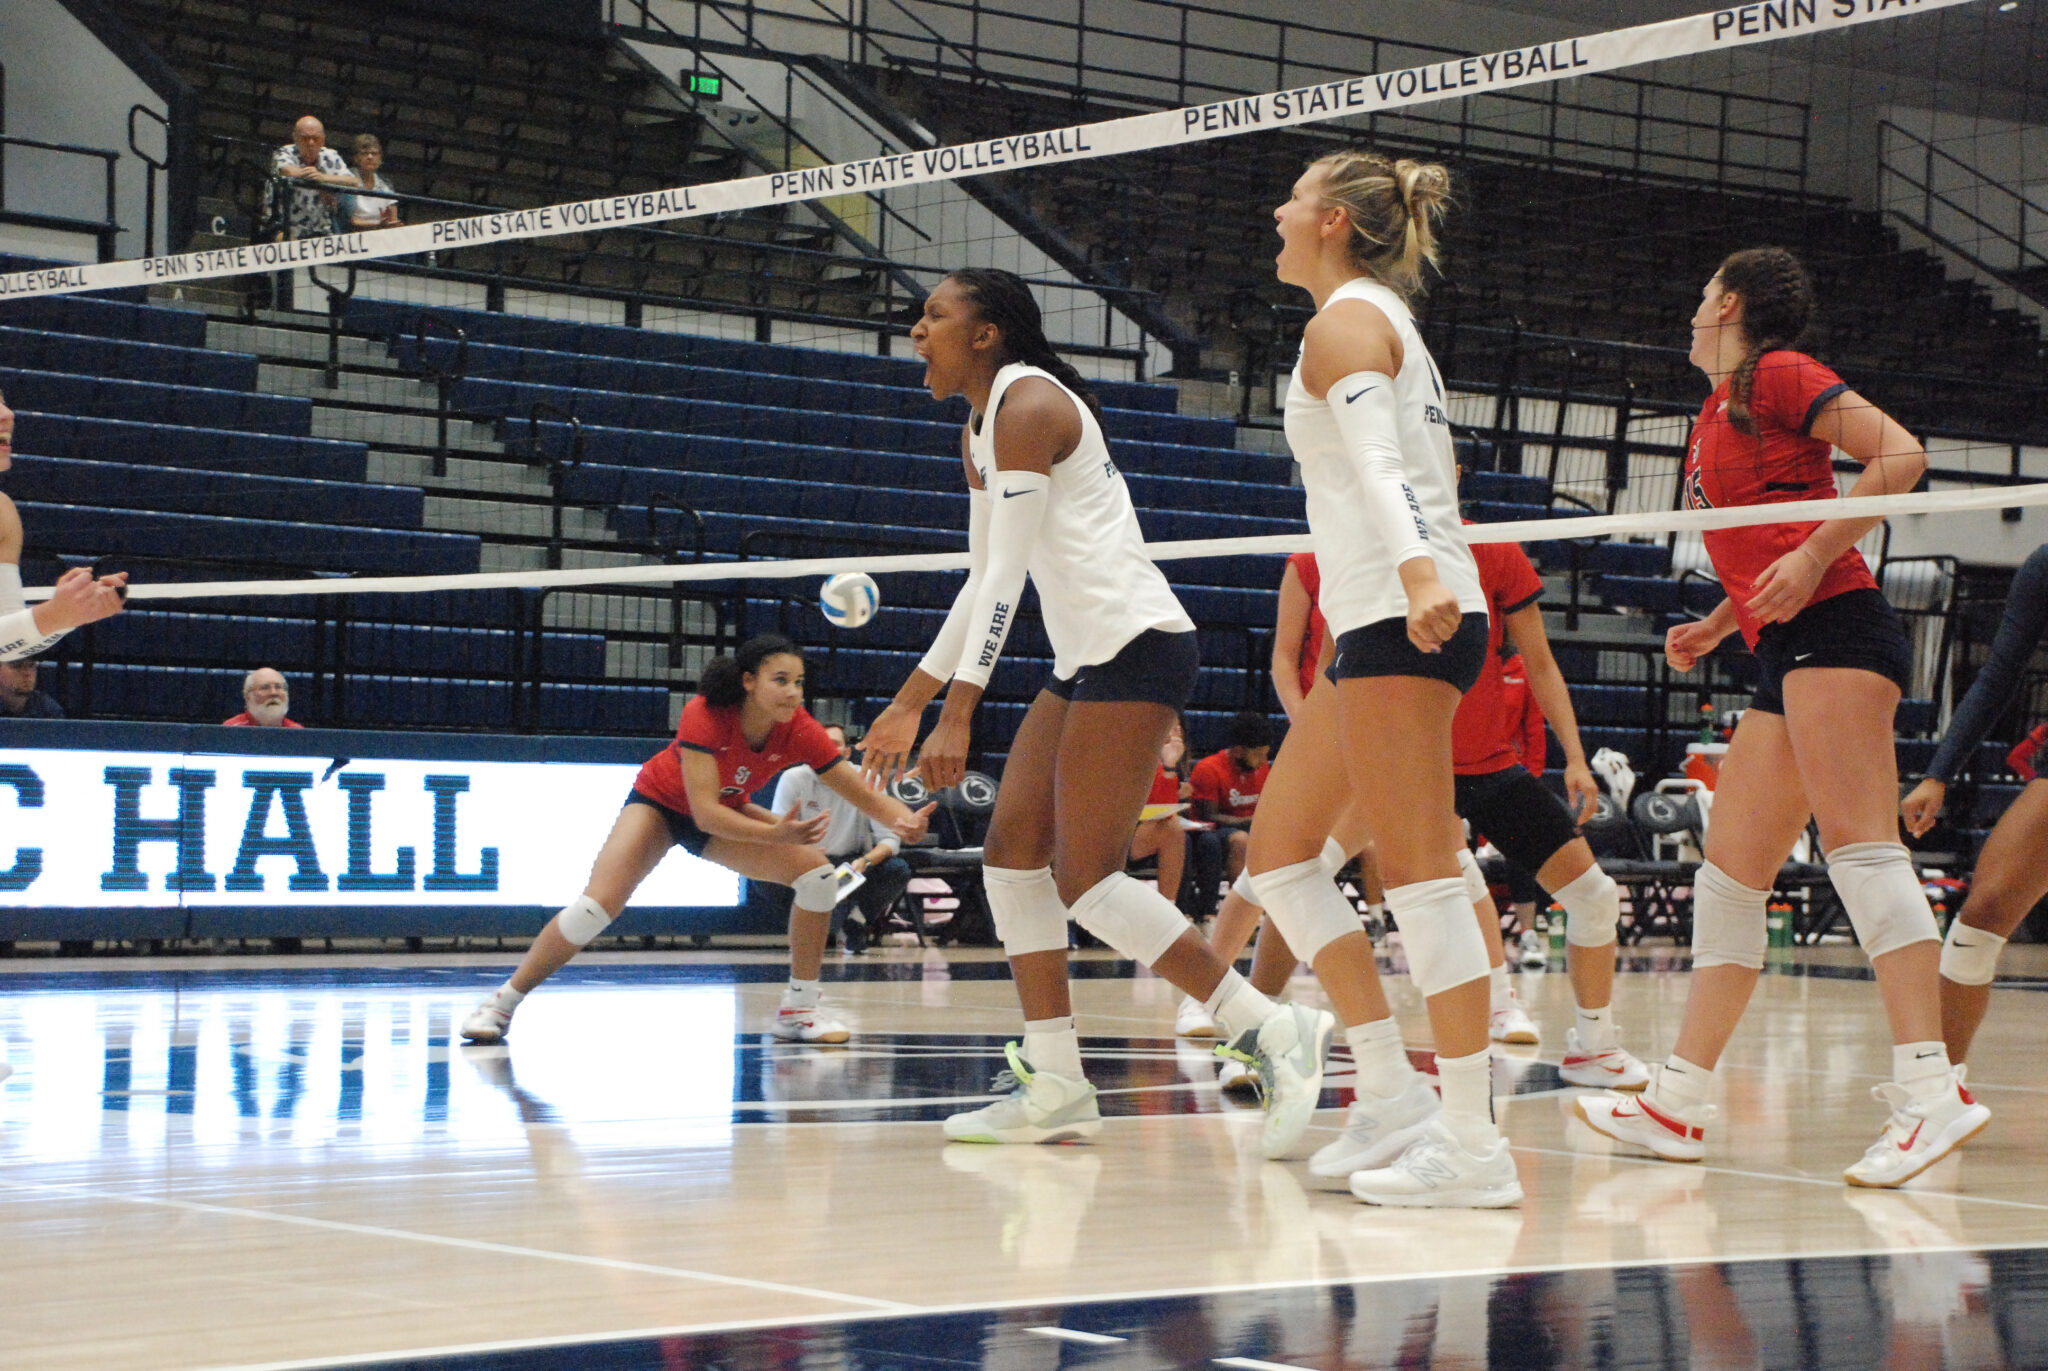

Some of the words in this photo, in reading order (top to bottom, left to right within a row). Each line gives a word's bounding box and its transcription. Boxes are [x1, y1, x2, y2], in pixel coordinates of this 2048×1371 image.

[1712, 0, 1816, 41] PENN
[1183, 99, 1261, 135] PENN
[1273, 78, 1365, 120] STATE
[1376, 39, 1589, 100] VOLLEYBALL
[771, 166, 834, 197] PENN
[842, 154, 914, 187] STATE
[923, 127, 1092, 175] VOLLEYBALL
[432, 218, 484, 244] PENN
[490, 209, 552, 235] STATE
[559, 188, 697, 227] VOLLEYBALL
[143, 257, 188, 279] PENN
[195, 248, 248, 273] STATE
[253, 233, 369, 266] VOLLEYBALL
[978, 640, 998, 667] WE
[989, 602, 1009, 638] ARE
[101, 766, 499, 892] HALL
